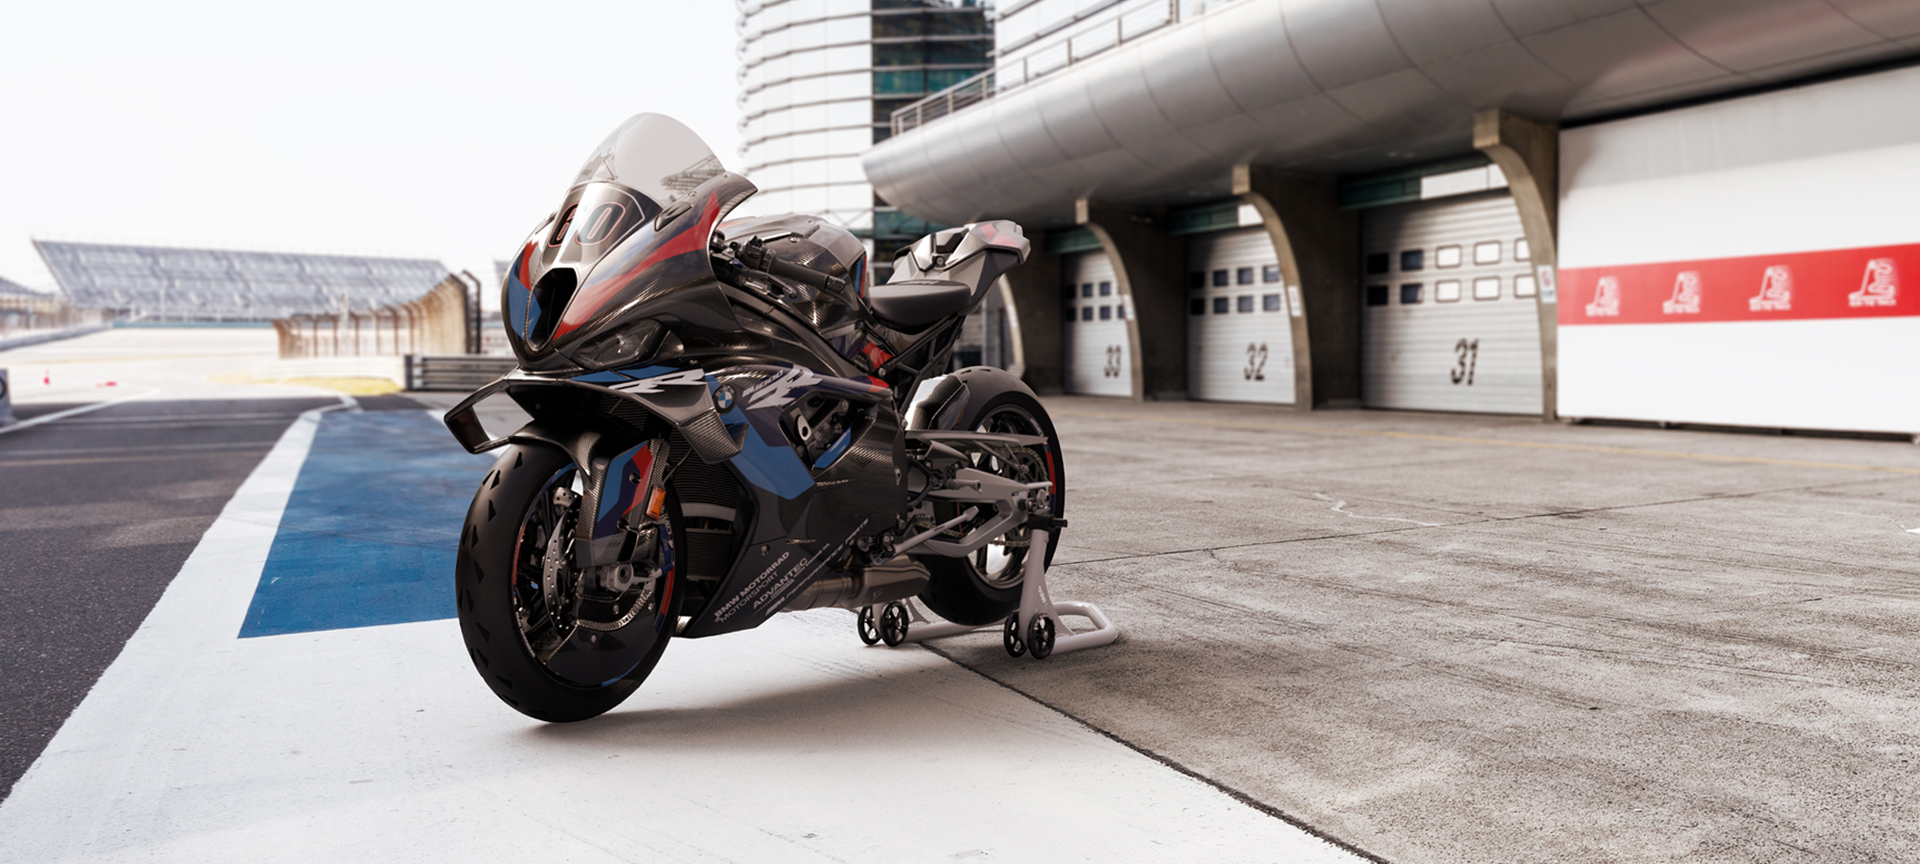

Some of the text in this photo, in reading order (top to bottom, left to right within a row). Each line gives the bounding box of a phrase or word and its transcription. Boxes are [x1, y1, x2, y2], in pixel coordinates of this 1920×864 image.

[1104, 346, 1121, 378] 33
[1244, 343, 1268, 382] 32
[1451, 338, 1479, 386] 31
[714, 551, 790, 617] BMW MOTORRAD
[720, 570, 778, 623] MOTORSPORT
[753, 557, 808, 609] ADVANTEC
